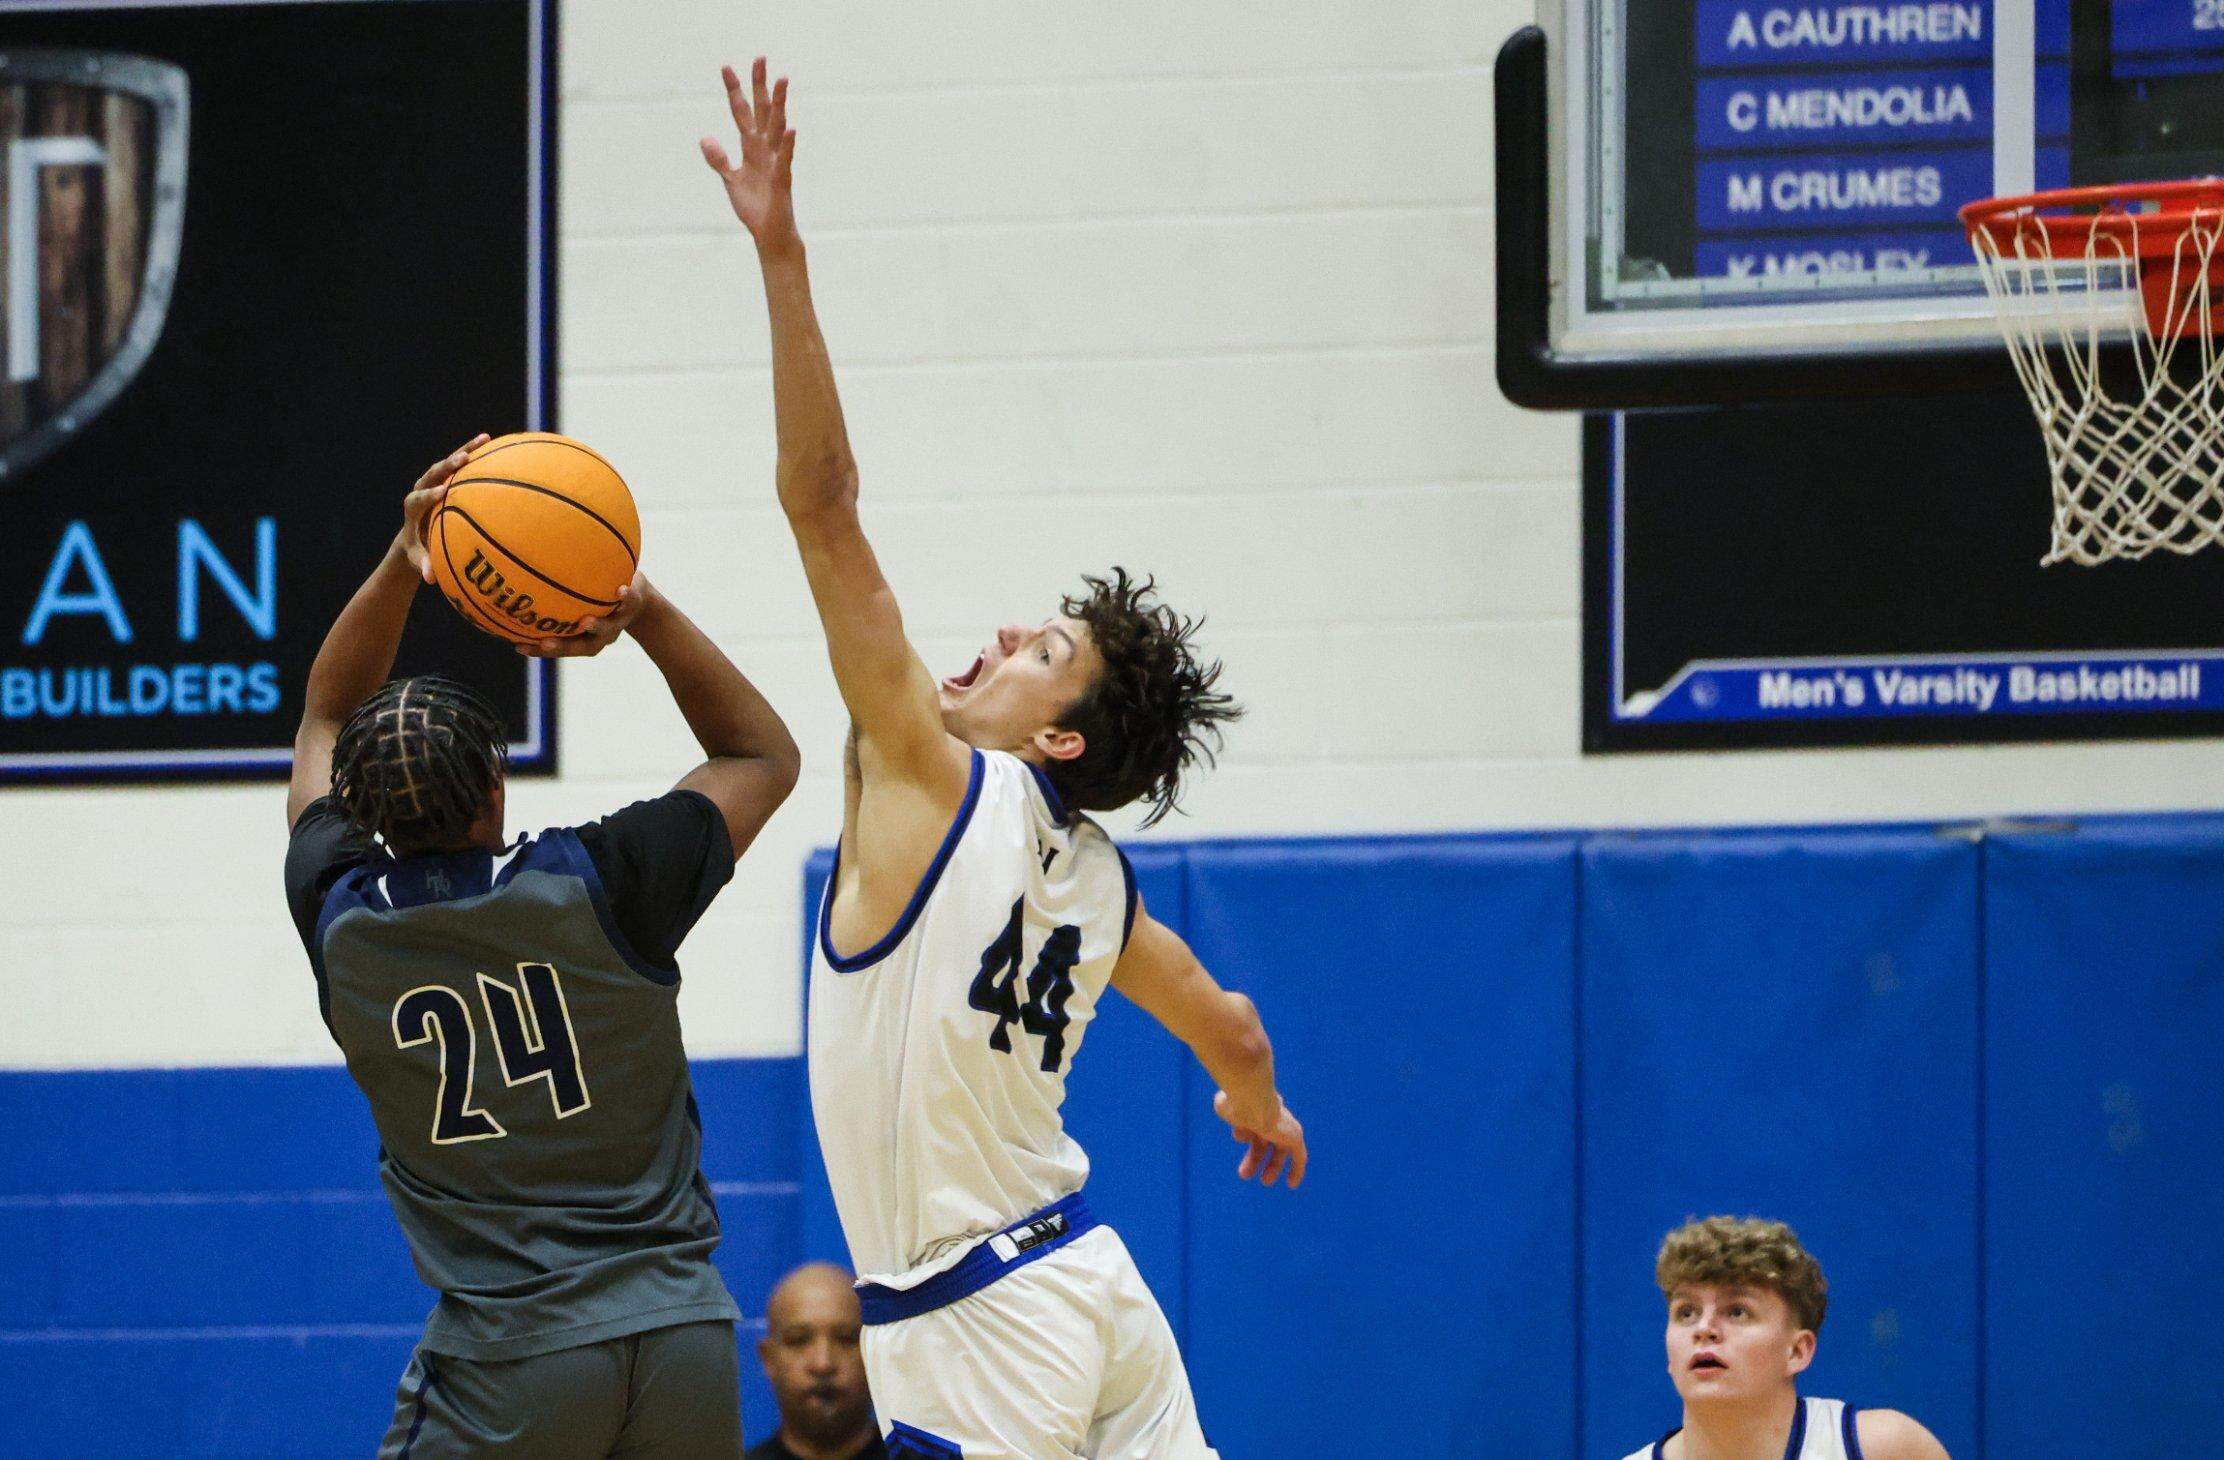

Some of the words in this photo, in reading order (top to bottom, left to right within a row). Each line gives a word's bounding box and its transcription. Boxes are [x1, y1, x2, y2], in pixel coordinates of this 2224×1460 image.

[1726, 12, 1757, 48] A
[1762, 2, 1981, 48] CAUTHREN
[1727, 92, 1758, 131] C
[1766, 85, 1973, 128] MENDOLIA
[1728, 174, 1762, 212] M
[1770, 166, 1942, 211] CRUMES
[0, 662, 281, 718] BUILDERS
[1758, 671, 1865, 708] Men's
[1872, 671, 1998, 712] Varsity
[2009, 663, 2200, 703] Basketball
[968, 891, 1082, 1074] 44
[391, 961, 593, 1146] 24
